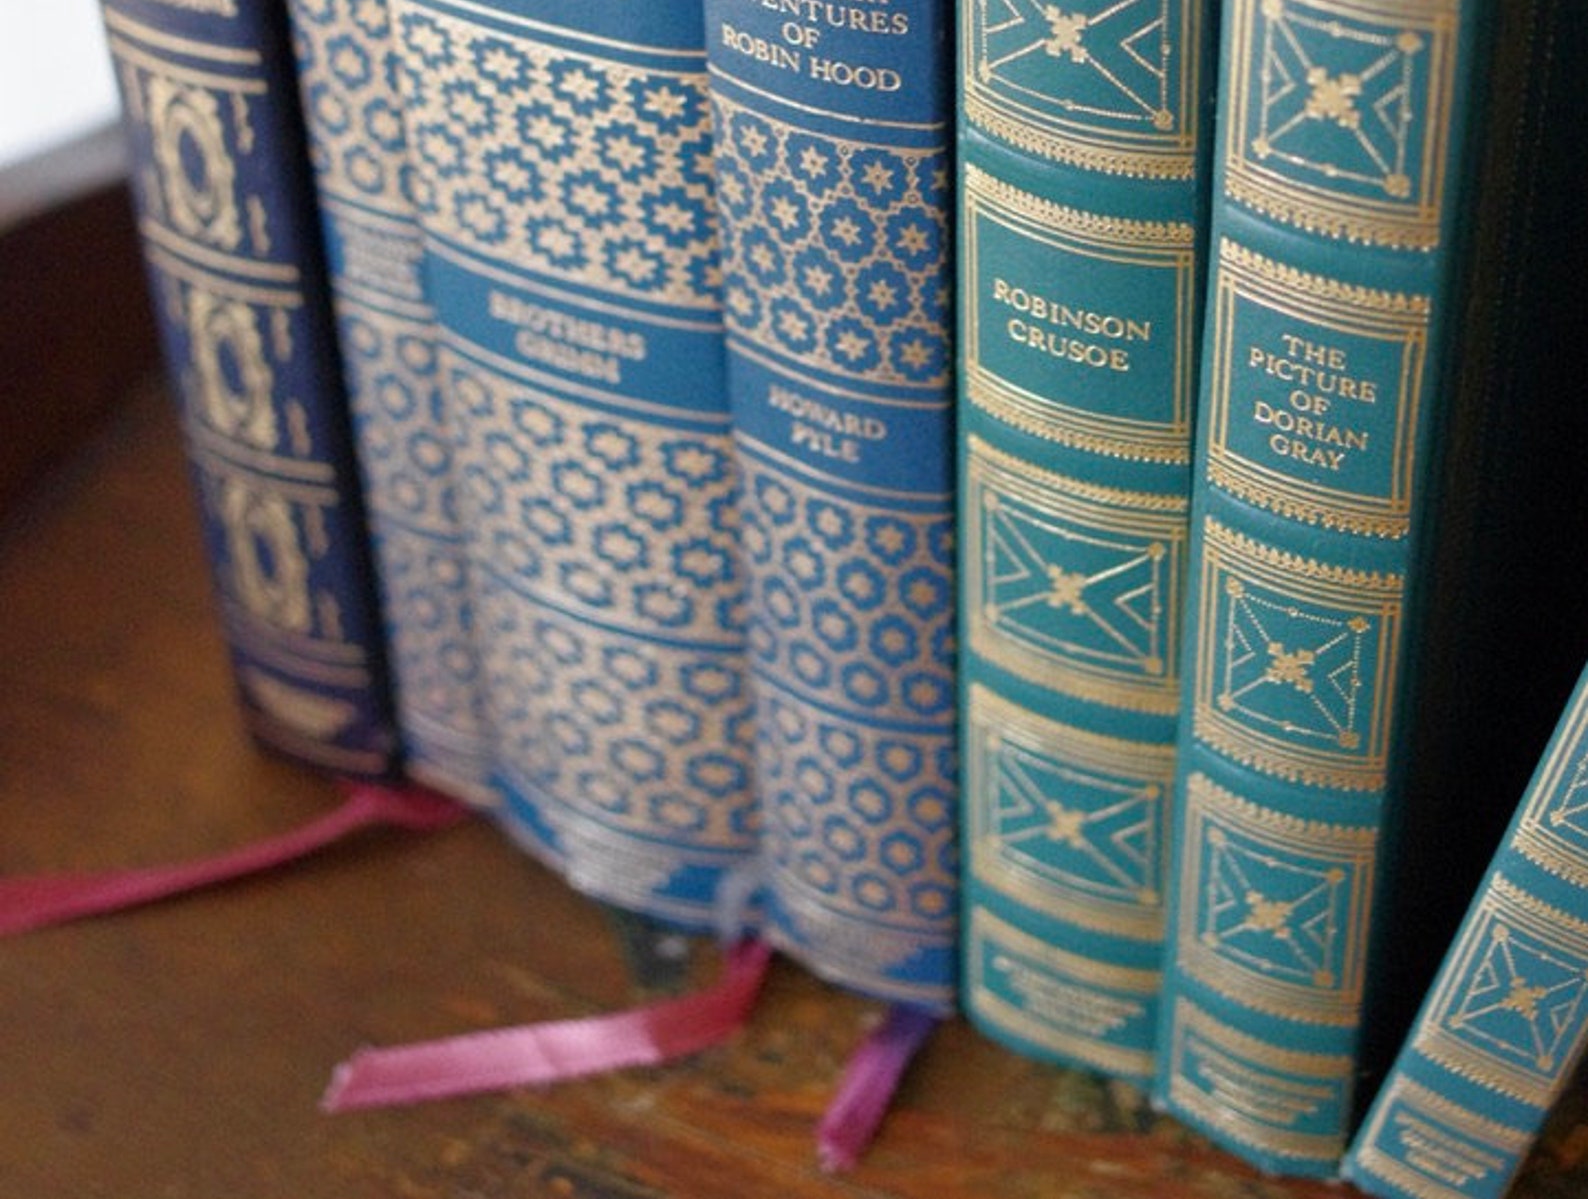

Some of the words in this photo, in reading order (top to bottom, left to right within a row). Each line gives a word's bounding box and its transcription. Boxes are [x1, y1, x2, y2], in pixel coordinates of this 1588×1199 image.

[721, 22, 800, 73] ROBIN
[808, 56, 902, 92] HOOD
[781, 20, 821, 49] OF
[993, 277, 1151, 341] ROBINSON
[1007, 318, 1130, 372] CRUSOE
[1281, 333, 1347, 371] THE
[1248, 346, 1378, 404] PICTURE
[1253, 400, 1370, 451] DORIAN
[1289, 389, 1331, 416] OF
[1269, 433, 1345, 471] GRAY
